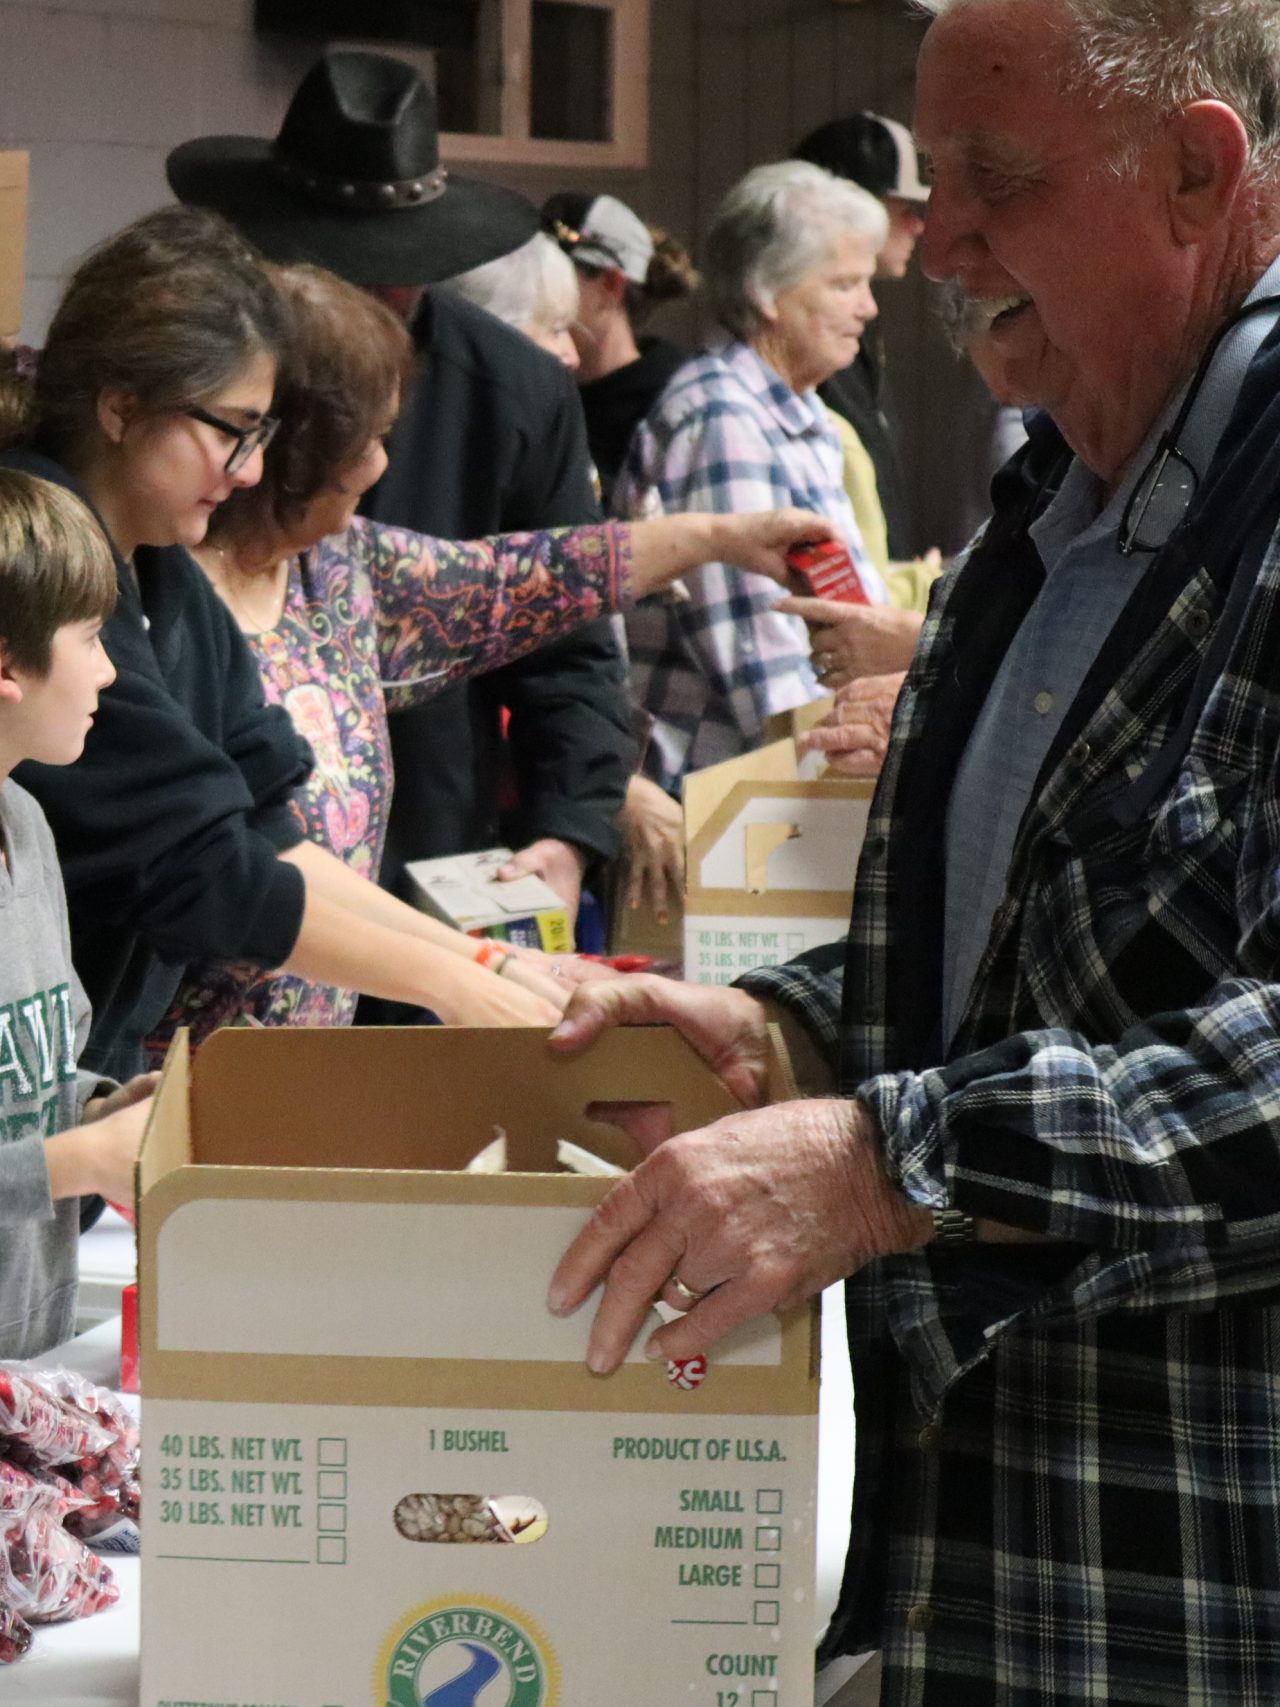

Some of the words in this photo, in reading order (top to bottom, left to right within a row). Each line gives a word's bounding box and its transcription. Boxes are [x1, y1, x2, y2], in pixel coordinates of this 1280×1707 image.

[739, 933, 758, 947] NET
[160, 1434, 183, 1457] 40
[189, 1435, 225, 1459] LBS.
[231, 1437, 266, 1460] NET
[272, 1438, 303, 1461] WT.
[443, 1430, 509, 1452] BUSHEL
[613, 1437, 701, 1460] PRODUCT
[706, 1438, 731, 1461] OF
[736, 1439, 787, 1462] U.S.A.
[160, 1467, 182, 1490] 35
[189, 1468, 225, 1492] LBS.
[231, 1470, 266, 1493] NET
[272, 1471, 303, 1494] WT.
[680, 1489, 744, 1512] SMALL
[160, 1500, 183, 1523] 30
[189, 1502, 225, 1525] LBS.
[231, 1503, 266, 1526] NET
[272, 1504, 303, 1527] WT.
[654, 1526, 743, 1549] MEDIUM
[678, 1564, 742, 1586] LARGE
[393, 1613, 537, 1683] RIVERBEND
[706, 1654, 778, 1676] COUNT
[716, 1691, 739, 1707] 12
